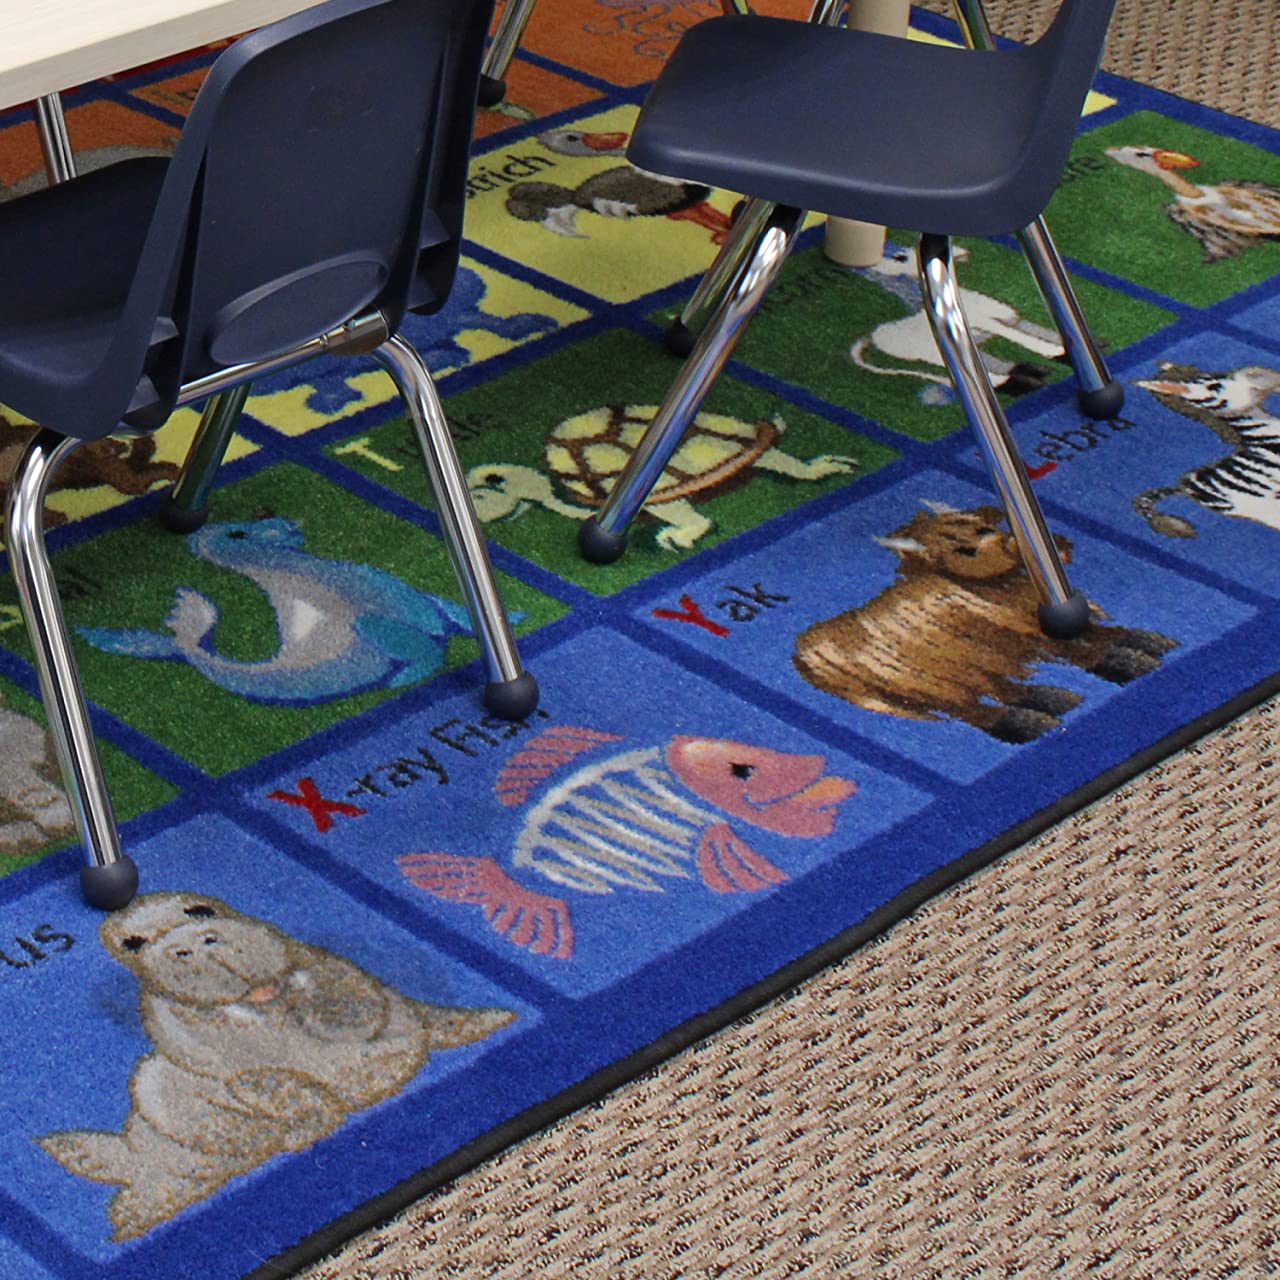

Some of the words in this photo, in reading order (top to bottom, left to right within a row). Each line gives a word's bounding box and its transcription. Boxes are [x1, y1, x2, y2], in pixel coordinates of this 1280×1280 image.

[464, 154, 558, 199] trich
[652, 578, 789, 637] Yak
[265, 745, 450, 833] X-ray
